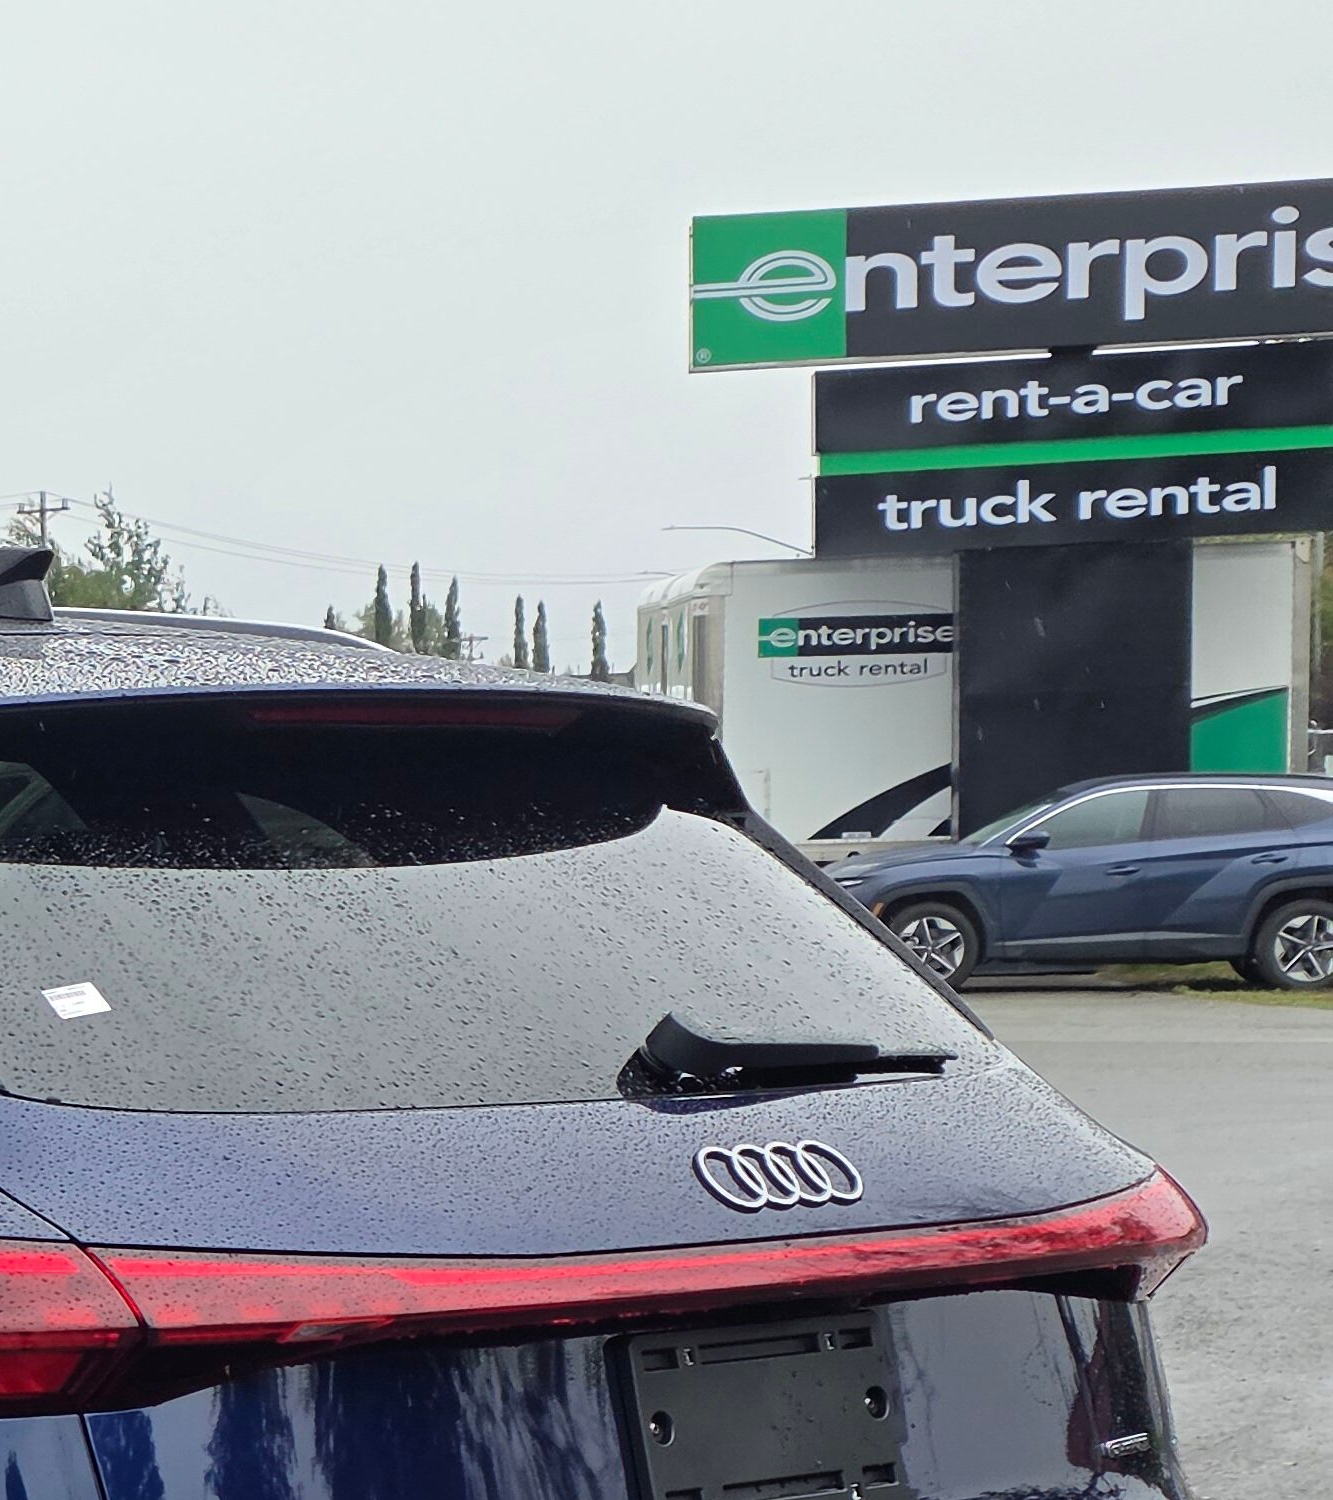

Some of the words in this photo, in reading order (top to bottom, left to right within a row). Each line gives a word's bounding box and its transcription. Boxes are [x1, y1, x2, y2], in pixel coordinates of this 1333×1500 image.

[910, 374, 1243, 424] rent-a-car
[878, 479, 1057, 532] truck
[1077, 465, 1276, 521] rental
[758, 620, 954, 650] enterprise
[788, 660, 850, 678] truck
[859, 658, 928, 677] rental
